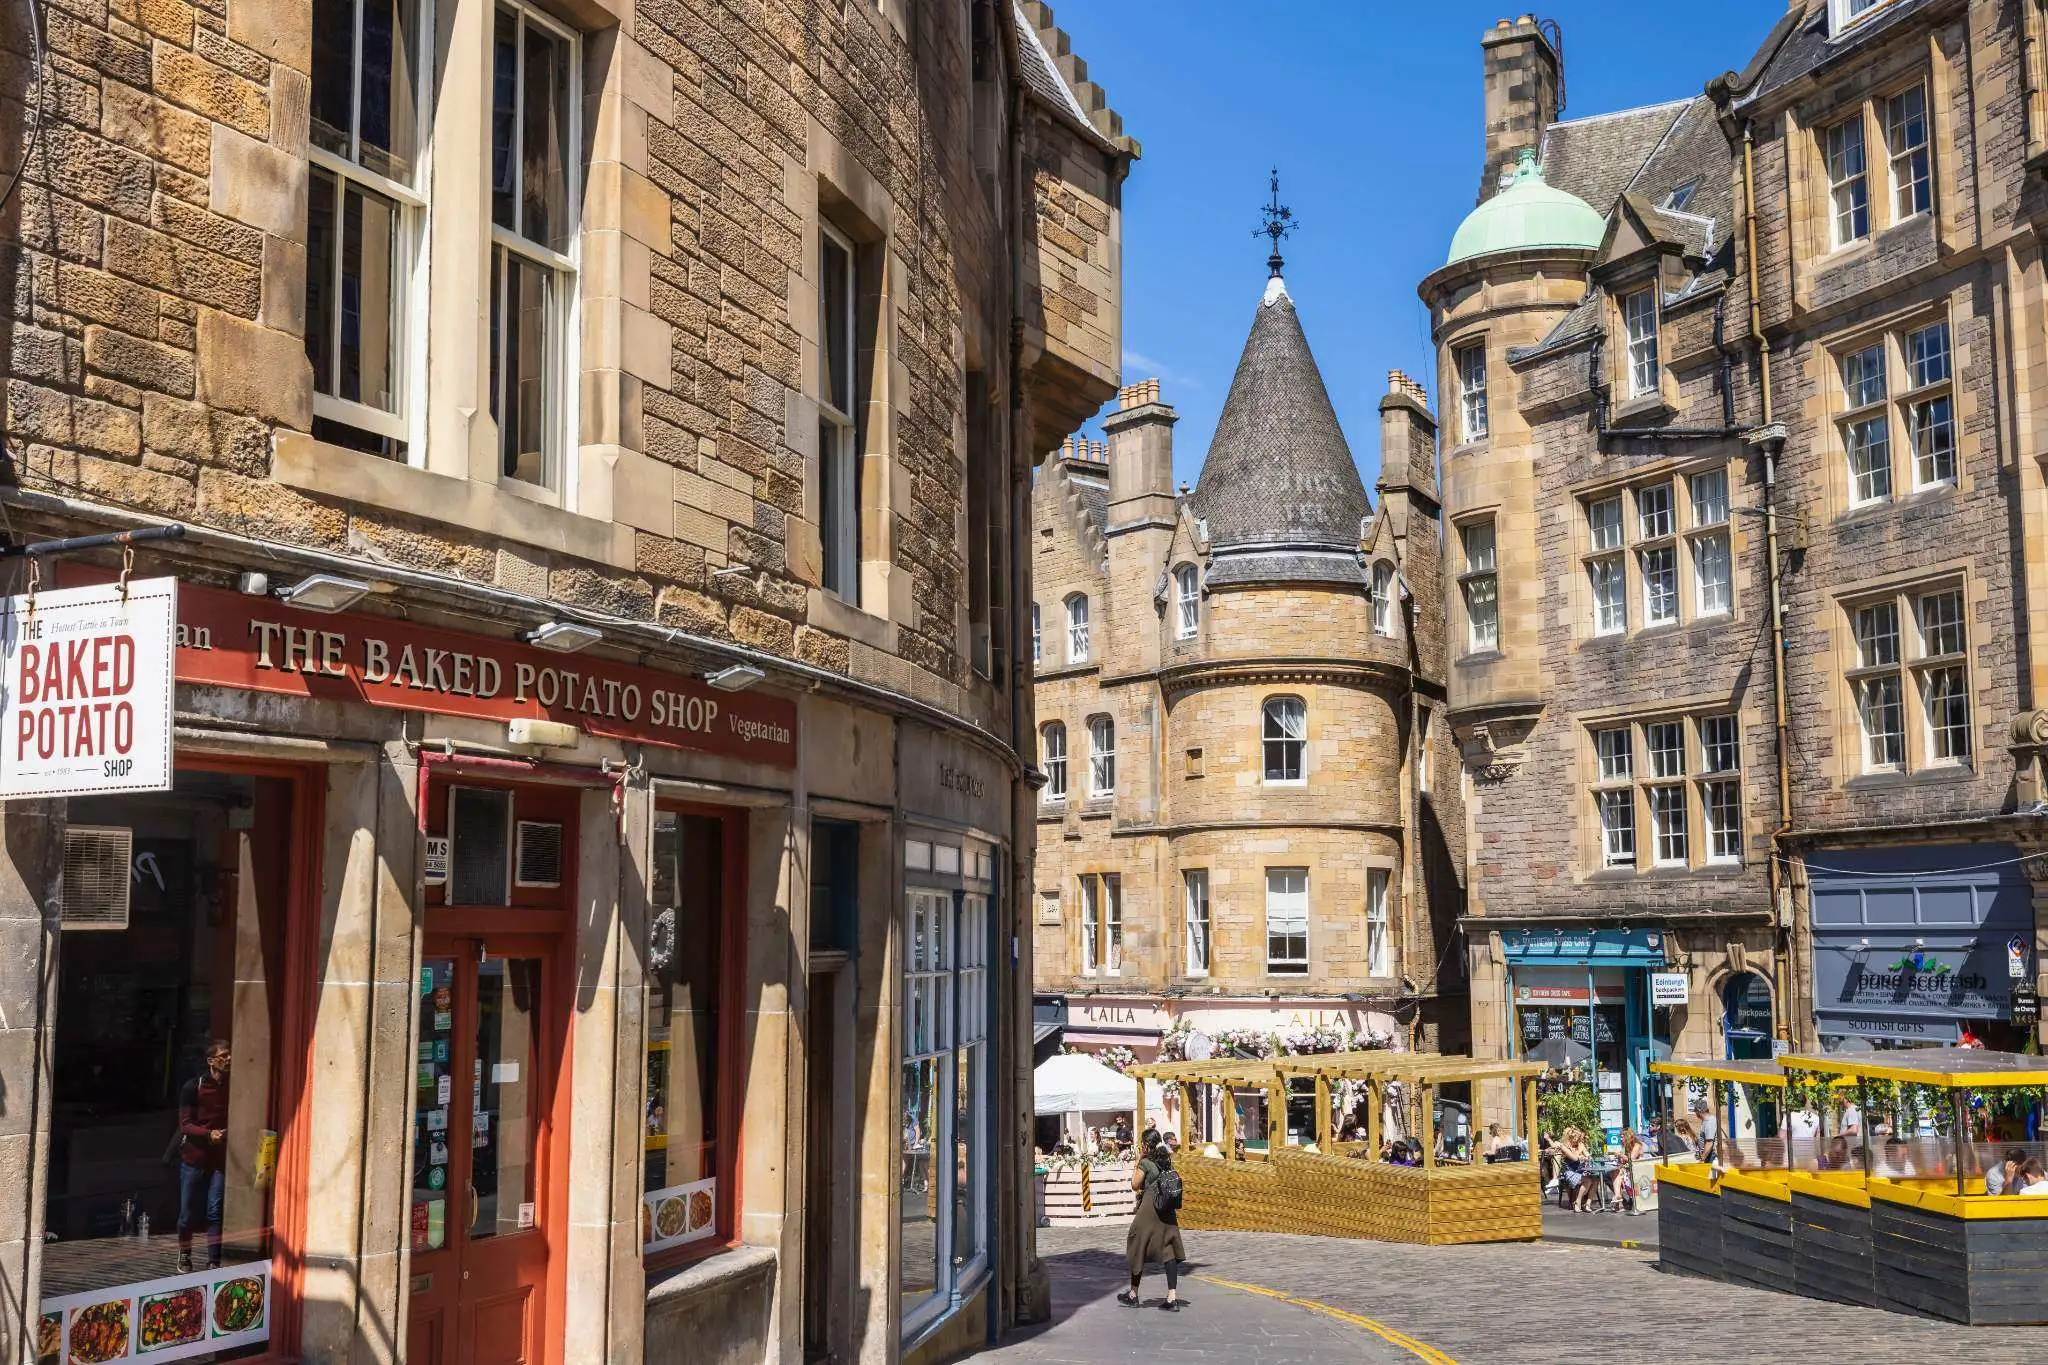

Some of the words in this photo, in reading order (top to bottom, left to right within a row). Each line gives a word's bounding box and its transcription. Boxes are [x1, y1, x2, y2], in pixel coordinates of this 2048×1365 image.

[22, 620, 43, 640] THE
[108, 616, 129, 627] Town
[19, 634, 135, 704] BAKED
[250, 618, 347, 678] THE
[362, 637, 502, 698] BAKED
[515, 662, 641, 721] POTATO
[651, 689, 718, 733] SHOP
[17, 701, 133, 761] POTATO
[729, 711, 791, 744] Vegetarian
[104, 759, 133, 777] SHOP
[1656, 978, 1684, 986] Edinburgh
[1858, 974, 1901, 990] pure
[1908, 972, 1987, 990] scottish
[1090, 1007, 1135, 1023] LAILA
[1276, 1010, 1346, 1028] AILA
[1848, 1019, 1893, 1031] SCOTTISH
[1898, 1022, 1924, 1033] GIFTS
